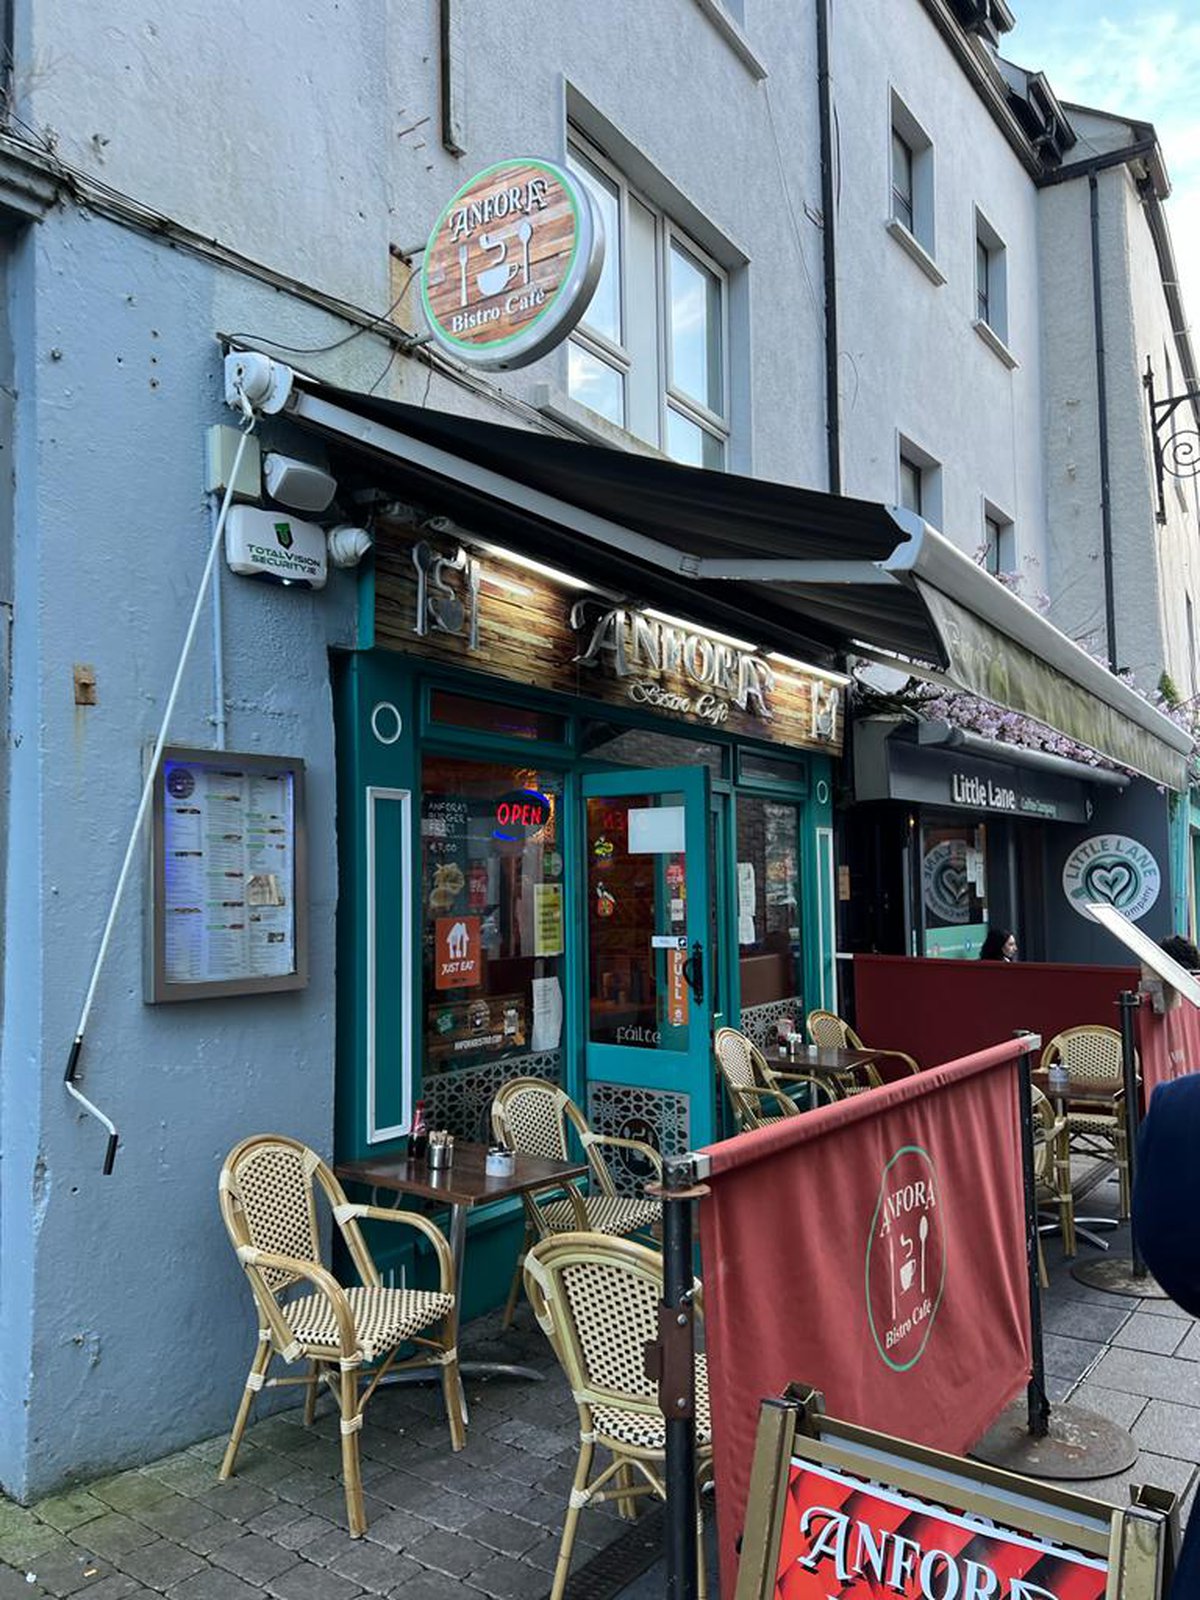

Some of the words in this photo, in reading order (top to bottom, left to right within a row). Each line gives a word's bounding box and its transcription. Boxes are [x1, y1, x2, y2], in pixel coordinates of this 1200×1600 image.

[450, 176, 549, 243] ANFORA
[451, 306, 500, 333] Bistro
[251, 554, 307, 574] SECURITY
[570, 599, 777, 722] ANFORA
[628, 677, 690, 713] Bistro
[953, 773, 987, 806] Little
[987, 780, 1016, 810] Lane
[496, 803, 542, 827] OPEN
[1065, 839, 1110, 880] LITTLE
[1115, 840, 1157, 878] LANE
[440, 961, 460, 976] JUST
[460, 960, 475, 972] EAT
[879, 1178, 936, 1238] ANFORA
[885, 1318, 912, 1350] Bistro
